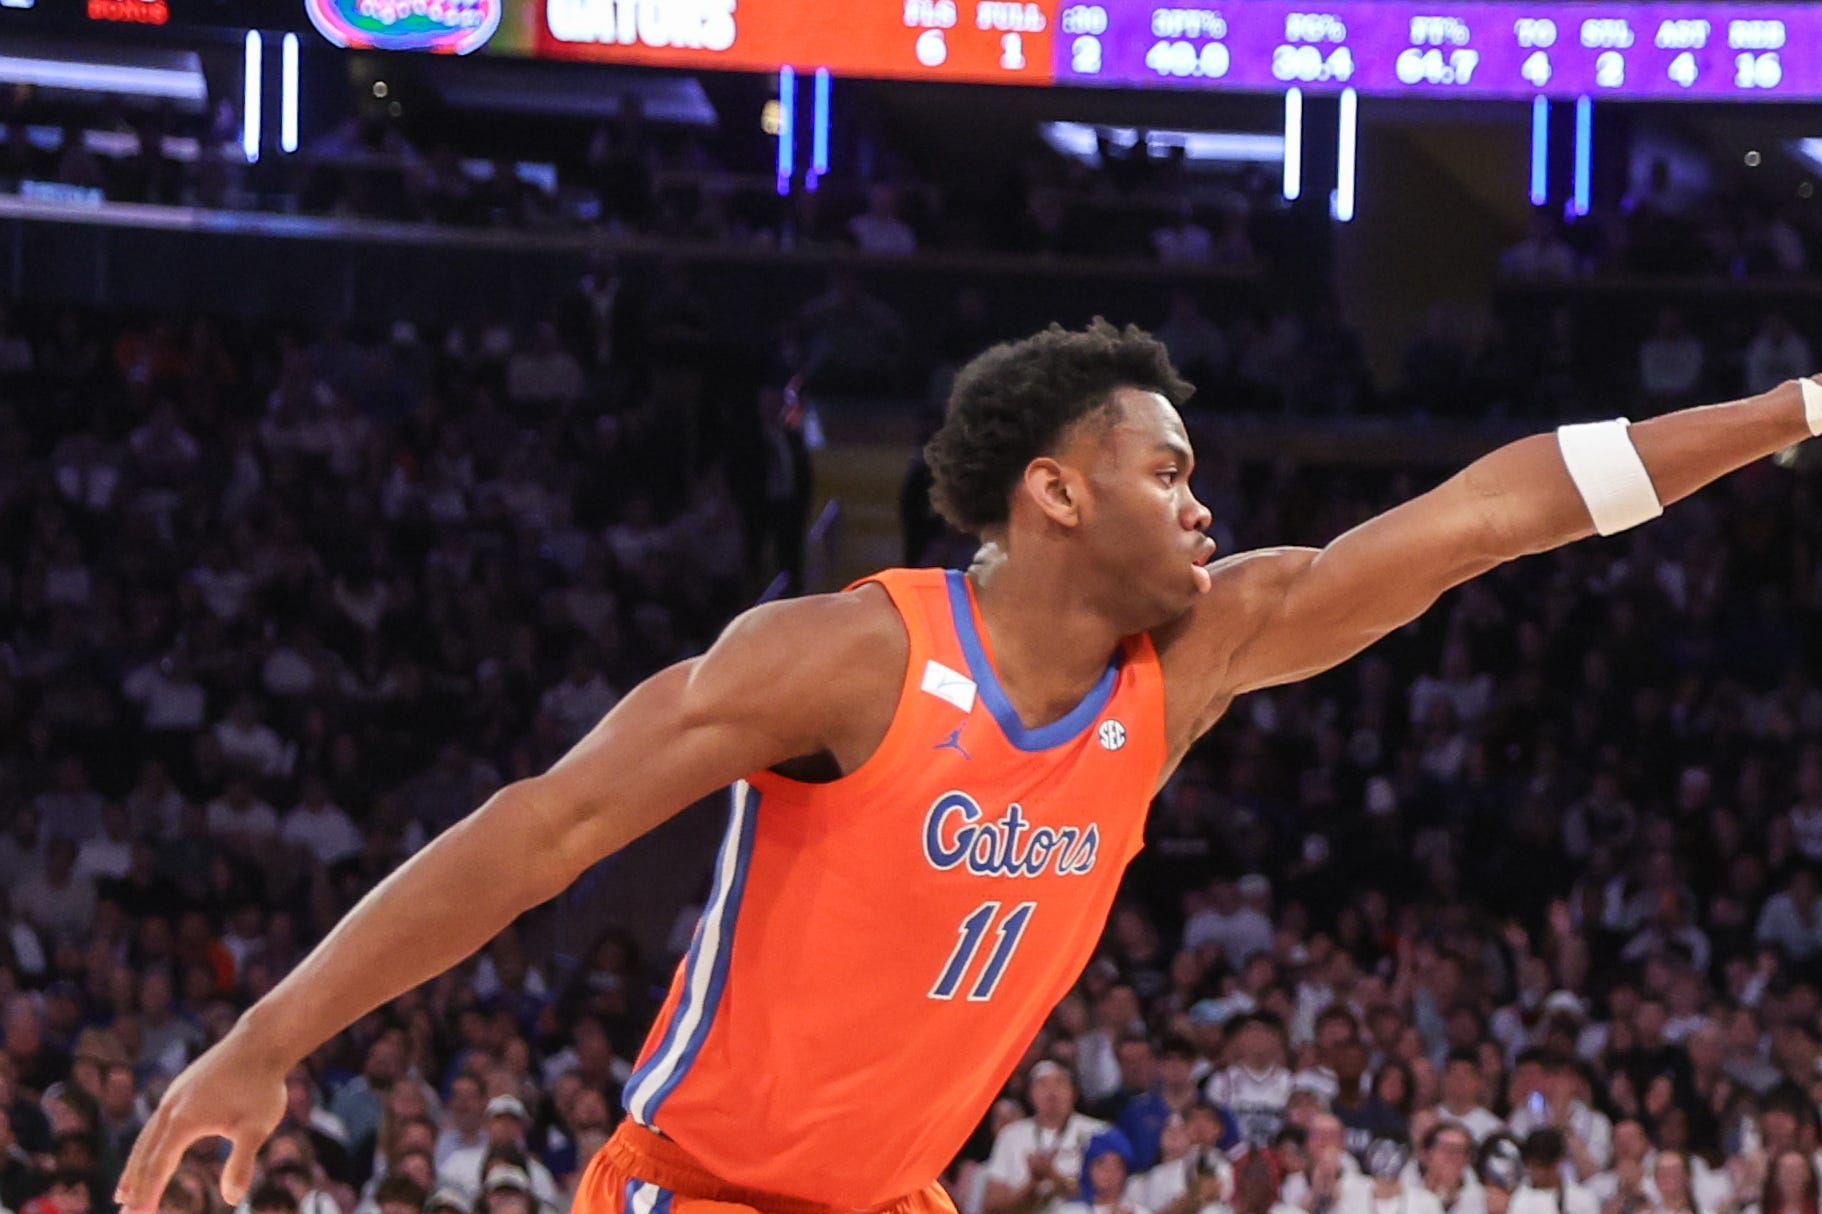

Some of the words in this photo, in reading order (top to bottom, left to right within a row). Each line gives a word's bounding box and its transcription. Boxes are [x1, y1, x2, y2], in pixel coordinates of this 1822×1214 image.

[916, 29, 947, 67] 6
[1000, 32, 1026, 70] 1
[1072, 35, 1102, 74] 2
[1396, 48, 1479, 85] 64.7
[1521, 51, 1552, 87] 4
[1667, 51, 1699, 87] 4
[1734, 52, 1783, 88] 16
[1098, 719, 1126, 751] SEC
[923, 790, 1100, 877] Gators
[927, 901, 1038, 1002] 11
